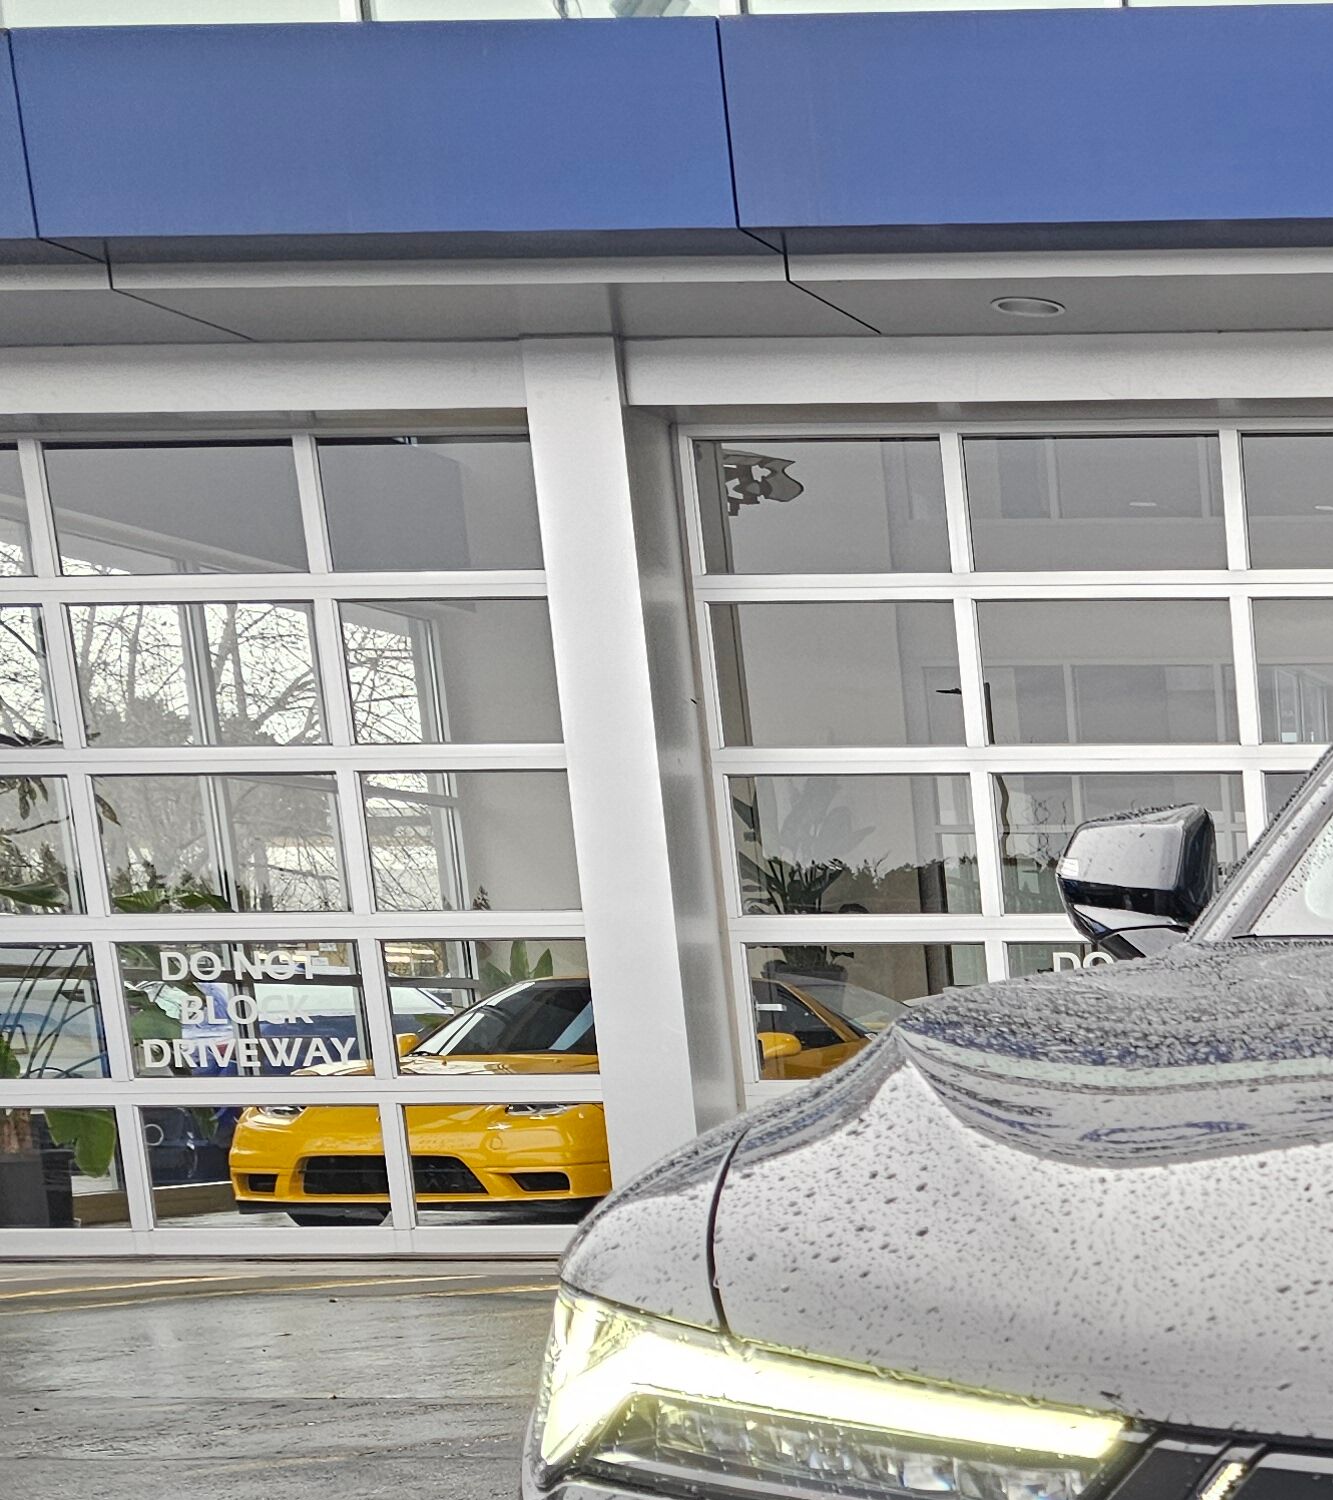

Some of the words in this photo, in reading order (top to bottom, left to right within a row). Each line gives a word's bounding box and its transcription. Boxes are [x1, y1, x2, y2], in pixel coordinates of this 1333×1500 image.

[160, 950, 222, 981] DO
[233, 950, 319, 981] NOT
[180, 994, 314, 1025] BLOCK
[142, 1037, 357, 1068] DRIVEWAY
